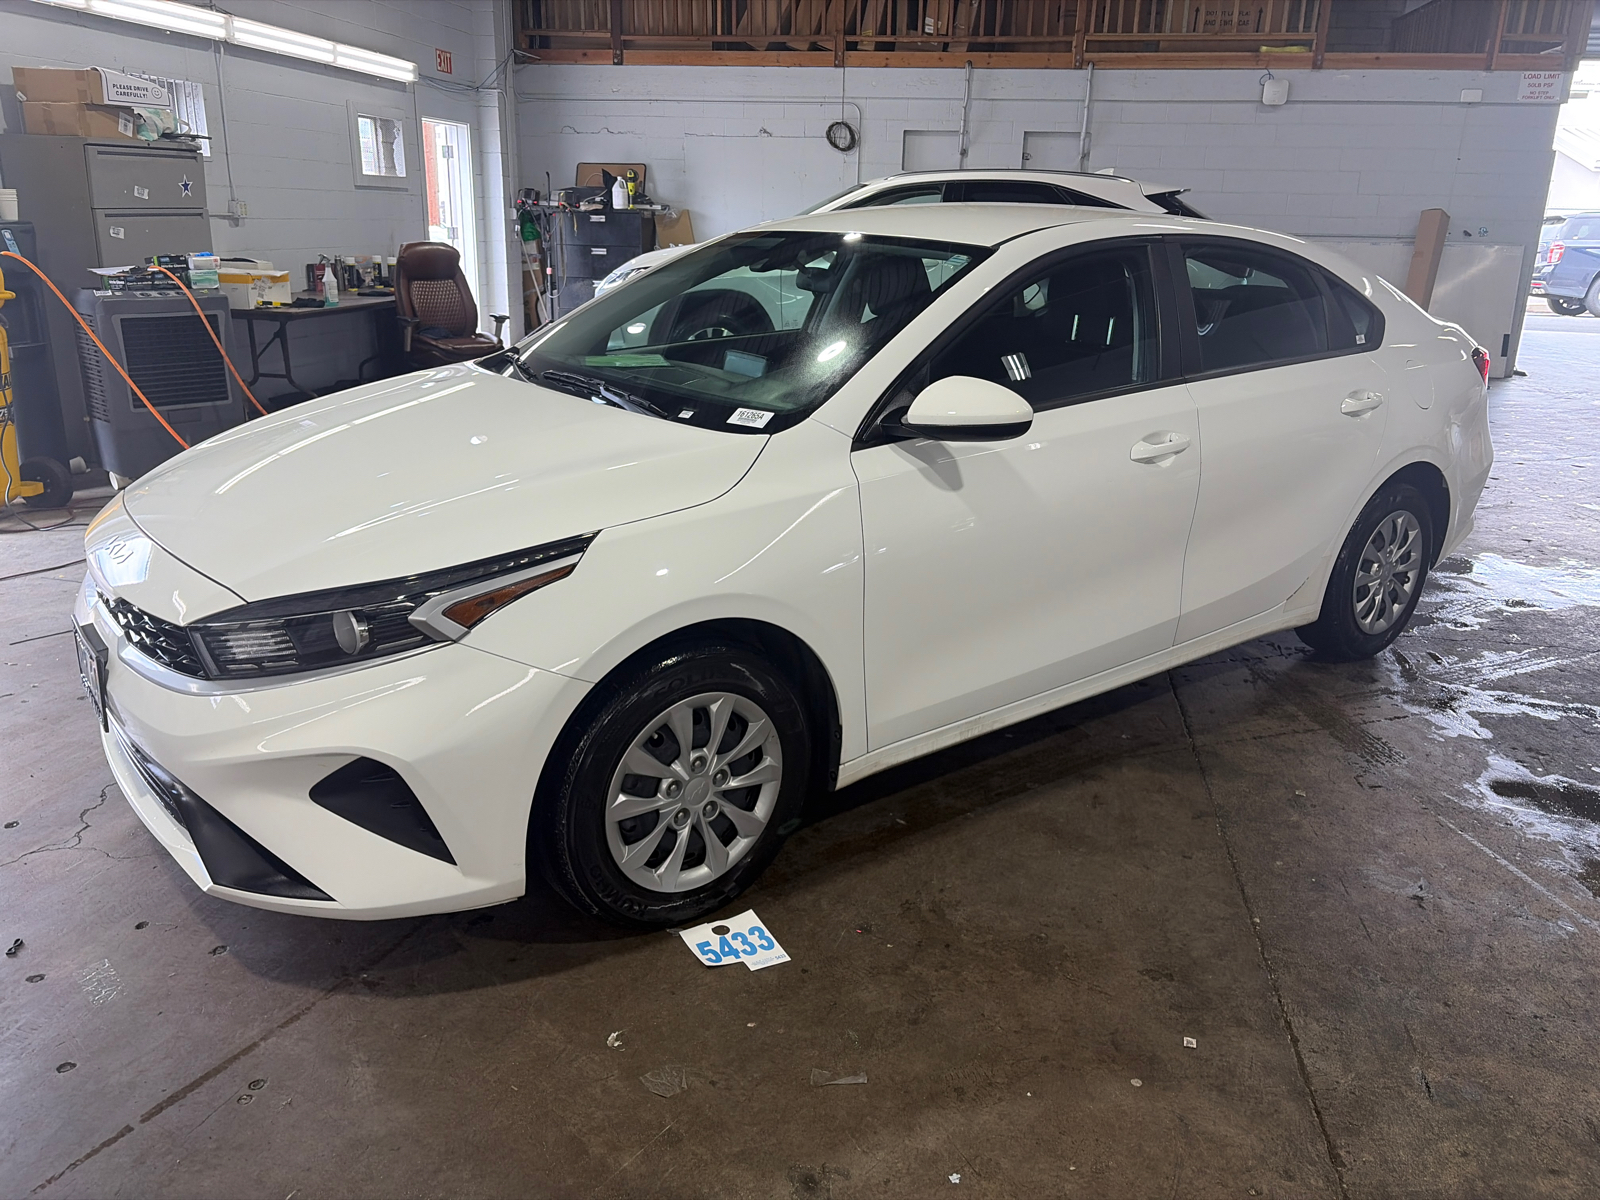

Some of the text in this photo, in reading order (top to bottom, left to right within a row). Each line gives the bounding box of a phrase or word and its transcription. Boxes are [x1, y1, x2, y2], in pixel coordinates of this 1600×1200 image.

[436, 50, 451, 73] EXIT
[112, 83, 149, 93] PLEASE DRIVE
[115, 90, 148, 99] CAREFULLY!
[695, 925, 776, 964] 5433
